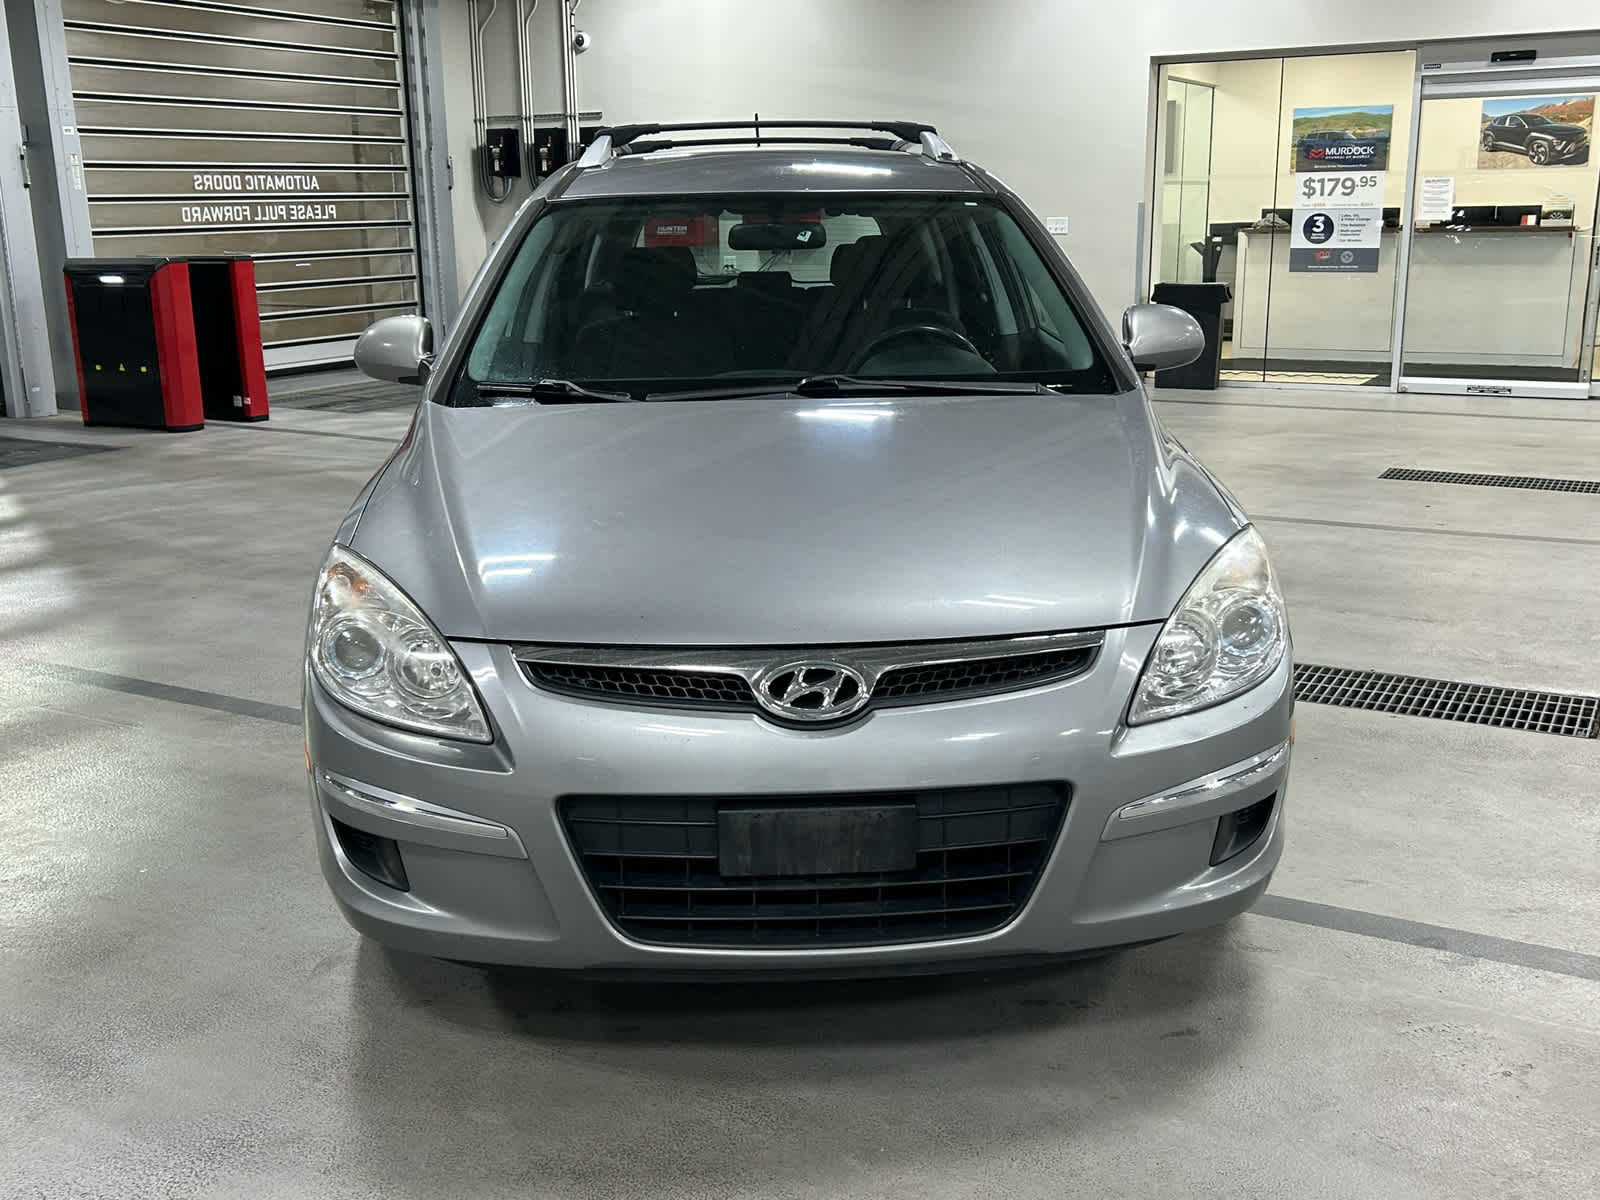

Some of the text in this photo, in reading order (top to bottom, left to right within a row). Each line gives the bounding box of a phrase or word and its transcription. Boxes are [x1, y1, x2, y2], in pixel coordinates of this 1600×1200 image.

[1325, 146, 1375, 155] MURDOCK
[1302, 176, 1377, 199] $179.95
[1312, 215, 1325, 233] 3
